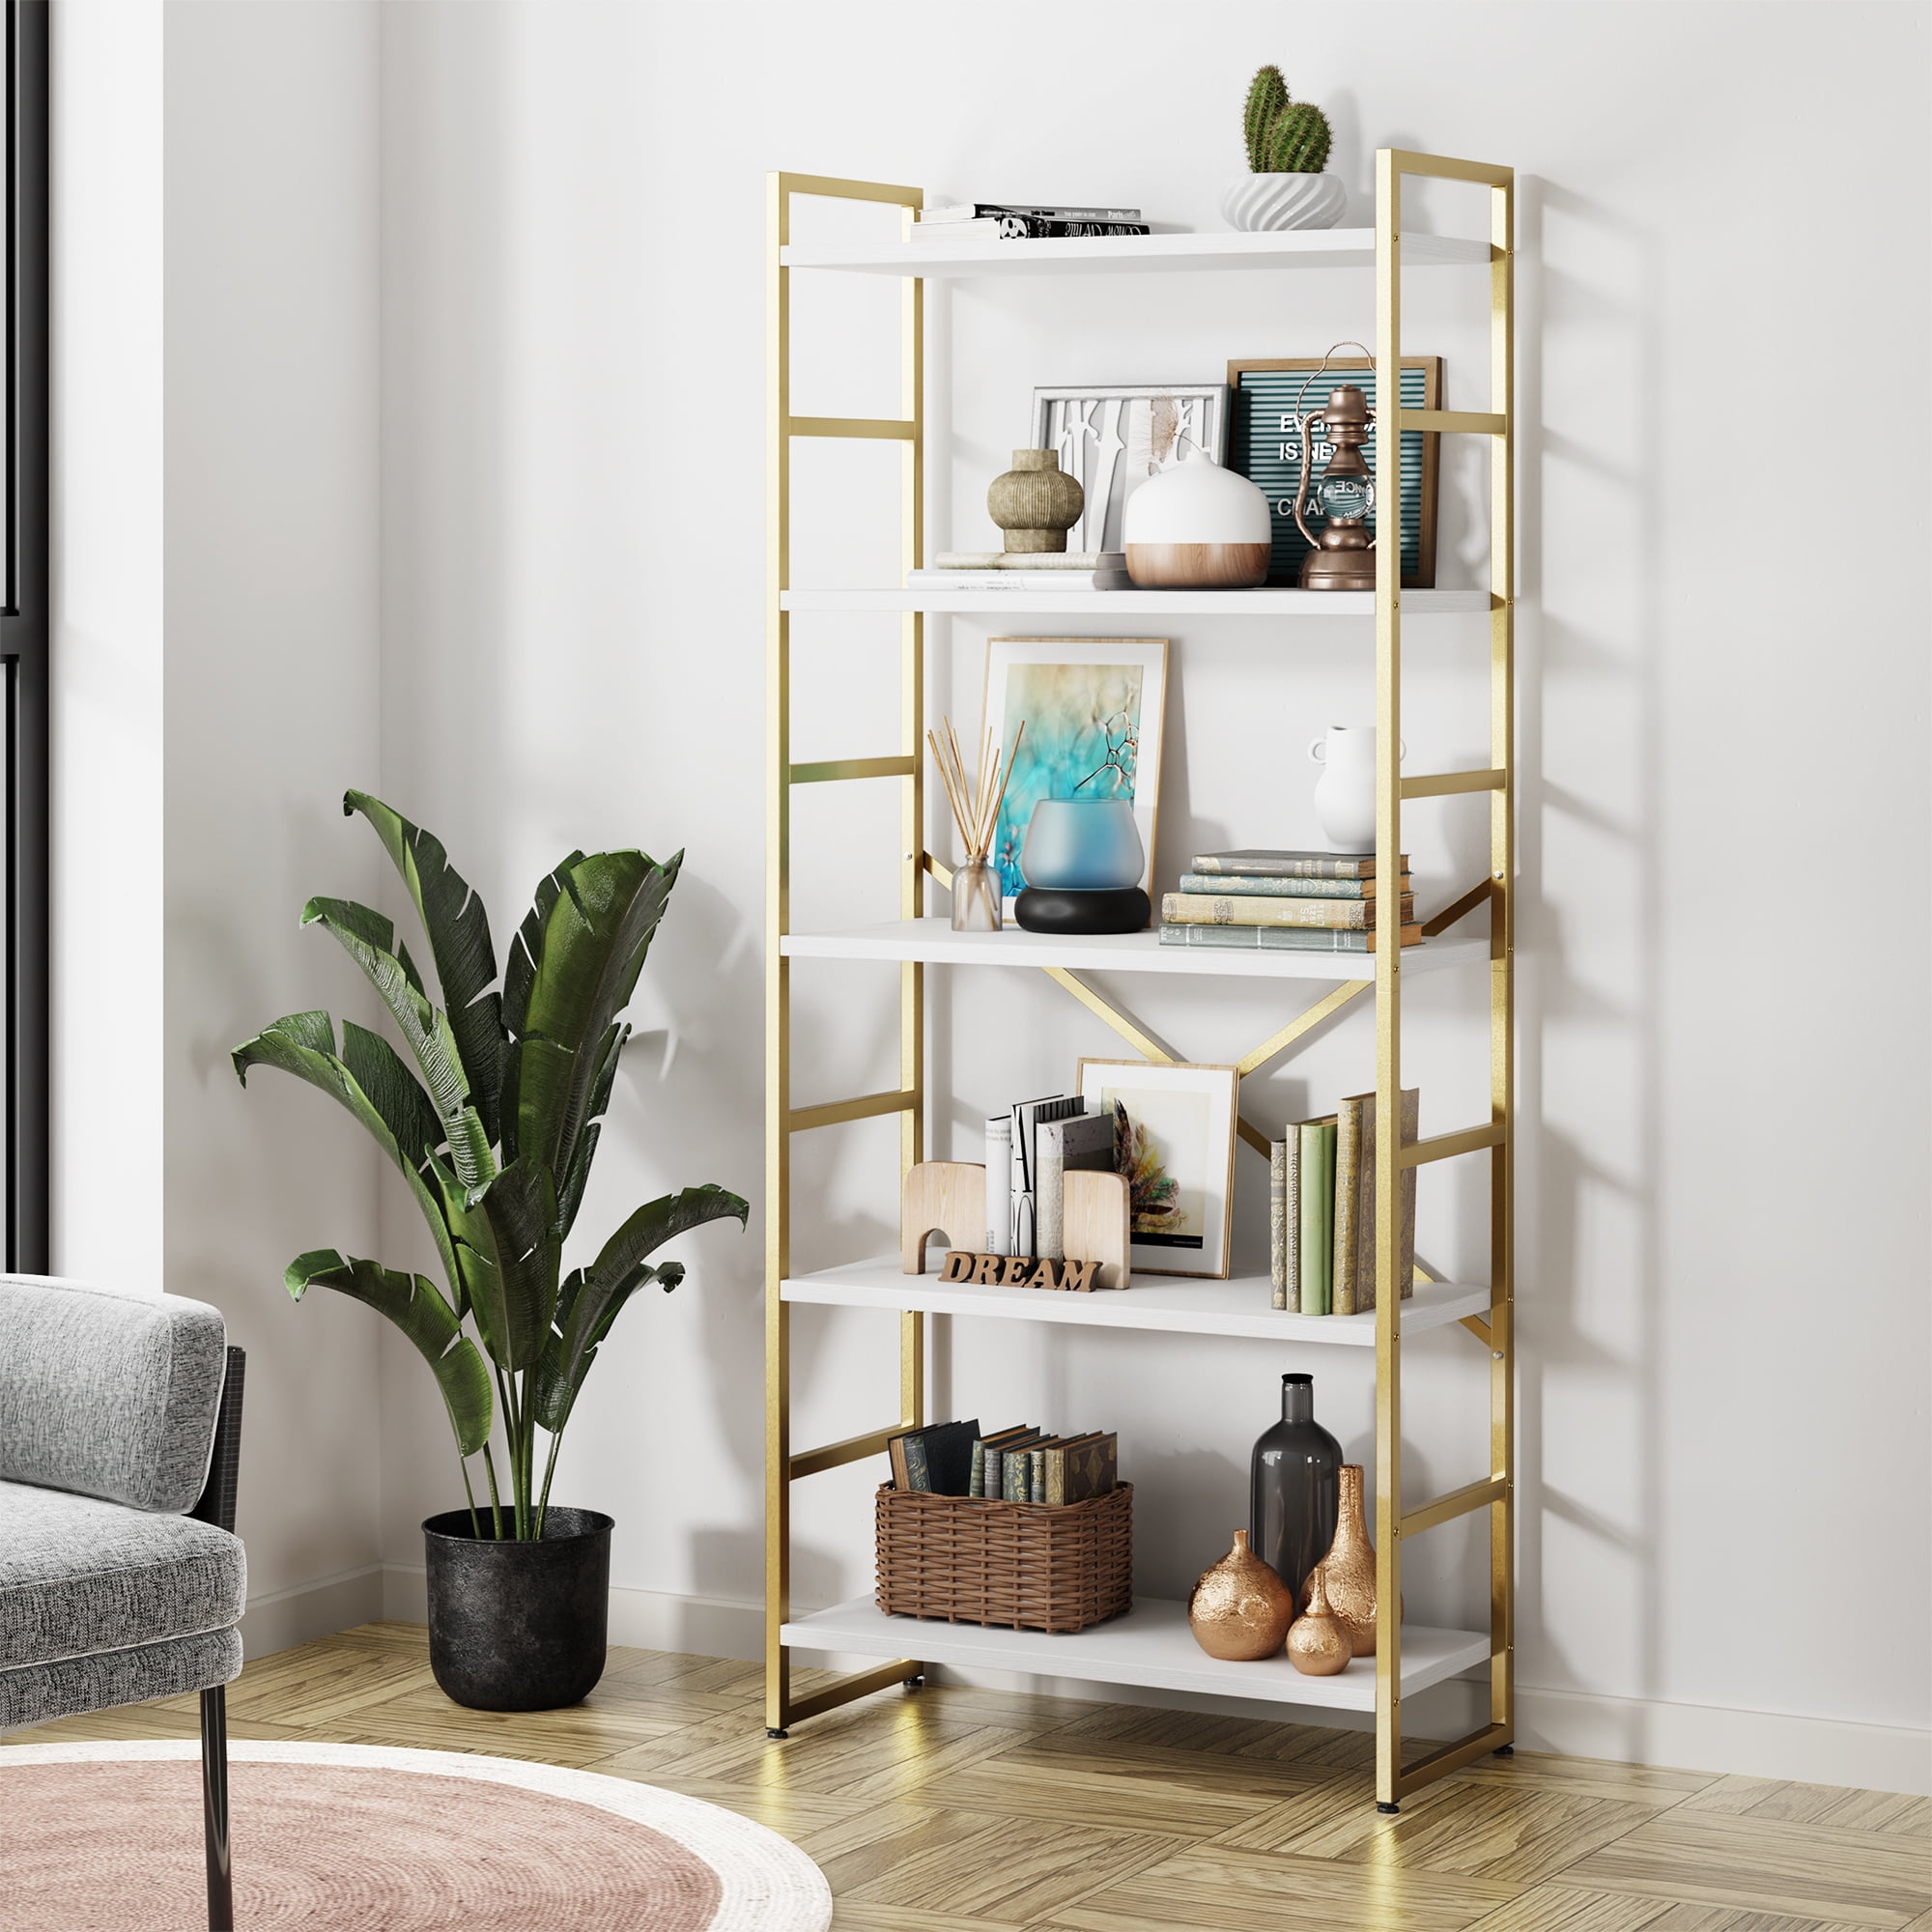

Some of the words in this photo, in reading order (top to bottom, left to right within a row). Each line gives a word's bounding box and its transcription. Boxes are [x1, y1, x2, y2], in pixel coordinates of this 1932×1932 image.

[1280, 442, 1298, 461] IS
[1311, 442, 1337, 460] NE
[937, 1251, 1103, 1293] DREAM
